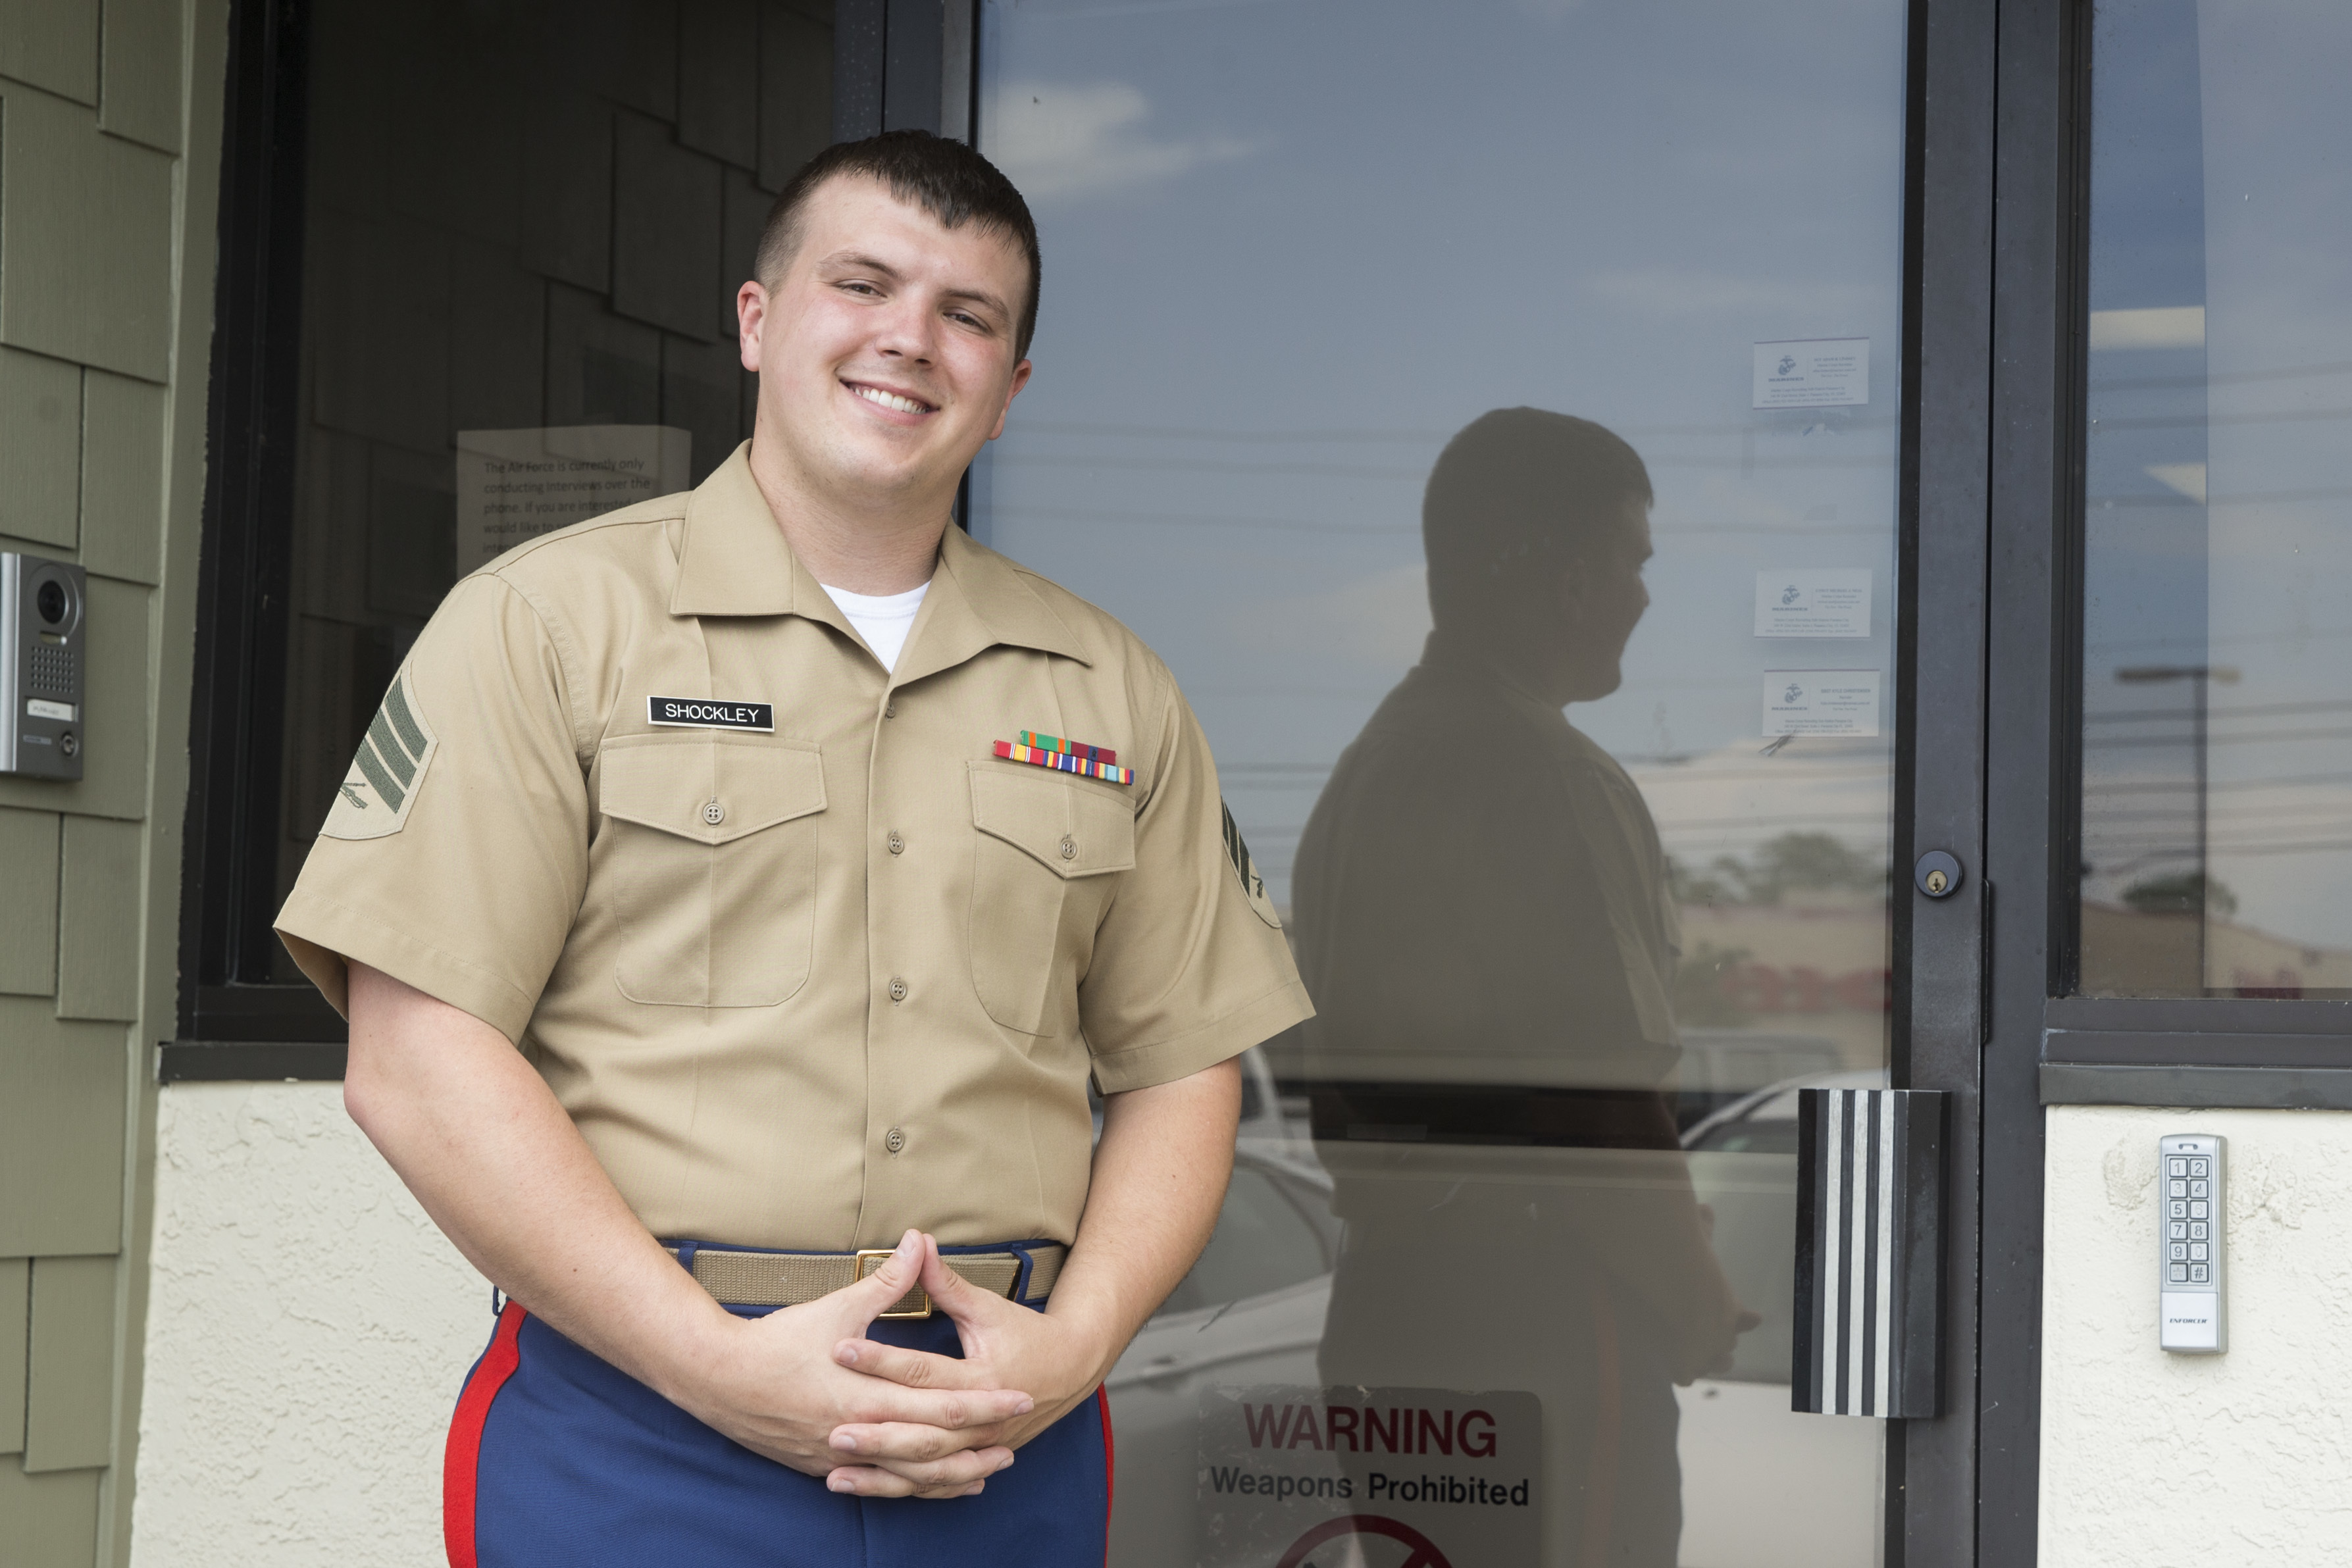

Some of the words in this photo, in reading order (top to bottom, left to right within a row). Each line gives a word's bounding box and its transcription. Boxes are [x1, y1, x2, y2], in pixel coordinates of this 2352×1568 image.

[485, 462, 505, 473] The
[508, 461, 524, 472] Air
[526, 461, 555, 472] Force
[557, 460, 566, 471] is
[569, 459, 616, 472] currently
[619, 457, 645, 471] only
[484, 481, 544, 495] conducting
[605, 480, 627, 490] over
[630, 476, 651, 490] the
[484, 501, 522, 517] phone.
[524, 500, 533, 513] If
[536, 503, 555, 515] you
[557, 502, 576, 513] are
[484, 521, 517, 534] would
[520, 521, 540, 534] like
[665, 703, 759, 722] SHOCKLEY
[2174, 1163, 2181, 1174] 1
[2195, 1162, 2203, 1174] 2
[2174, 1183, 2182, 1195] 3
[2195, 1183, 2203, 1195] 4
[2174, 1204, 2182, 1215] 5
[2195, 1203, 2203, 1215] 6
[2174, 1225, 2182, 1236] 7
[2195, 1225, 2203, 1236] 8
[2174, 1246, 2182, 1257] 9
[2195, 1246, 2203, 1257] 0
[1243, 1403, 1496, 1458] WARNING
[1210, 1466, 1353, 1502] Weapons
[1368, 1473, 1529, 1507] Prohibited
